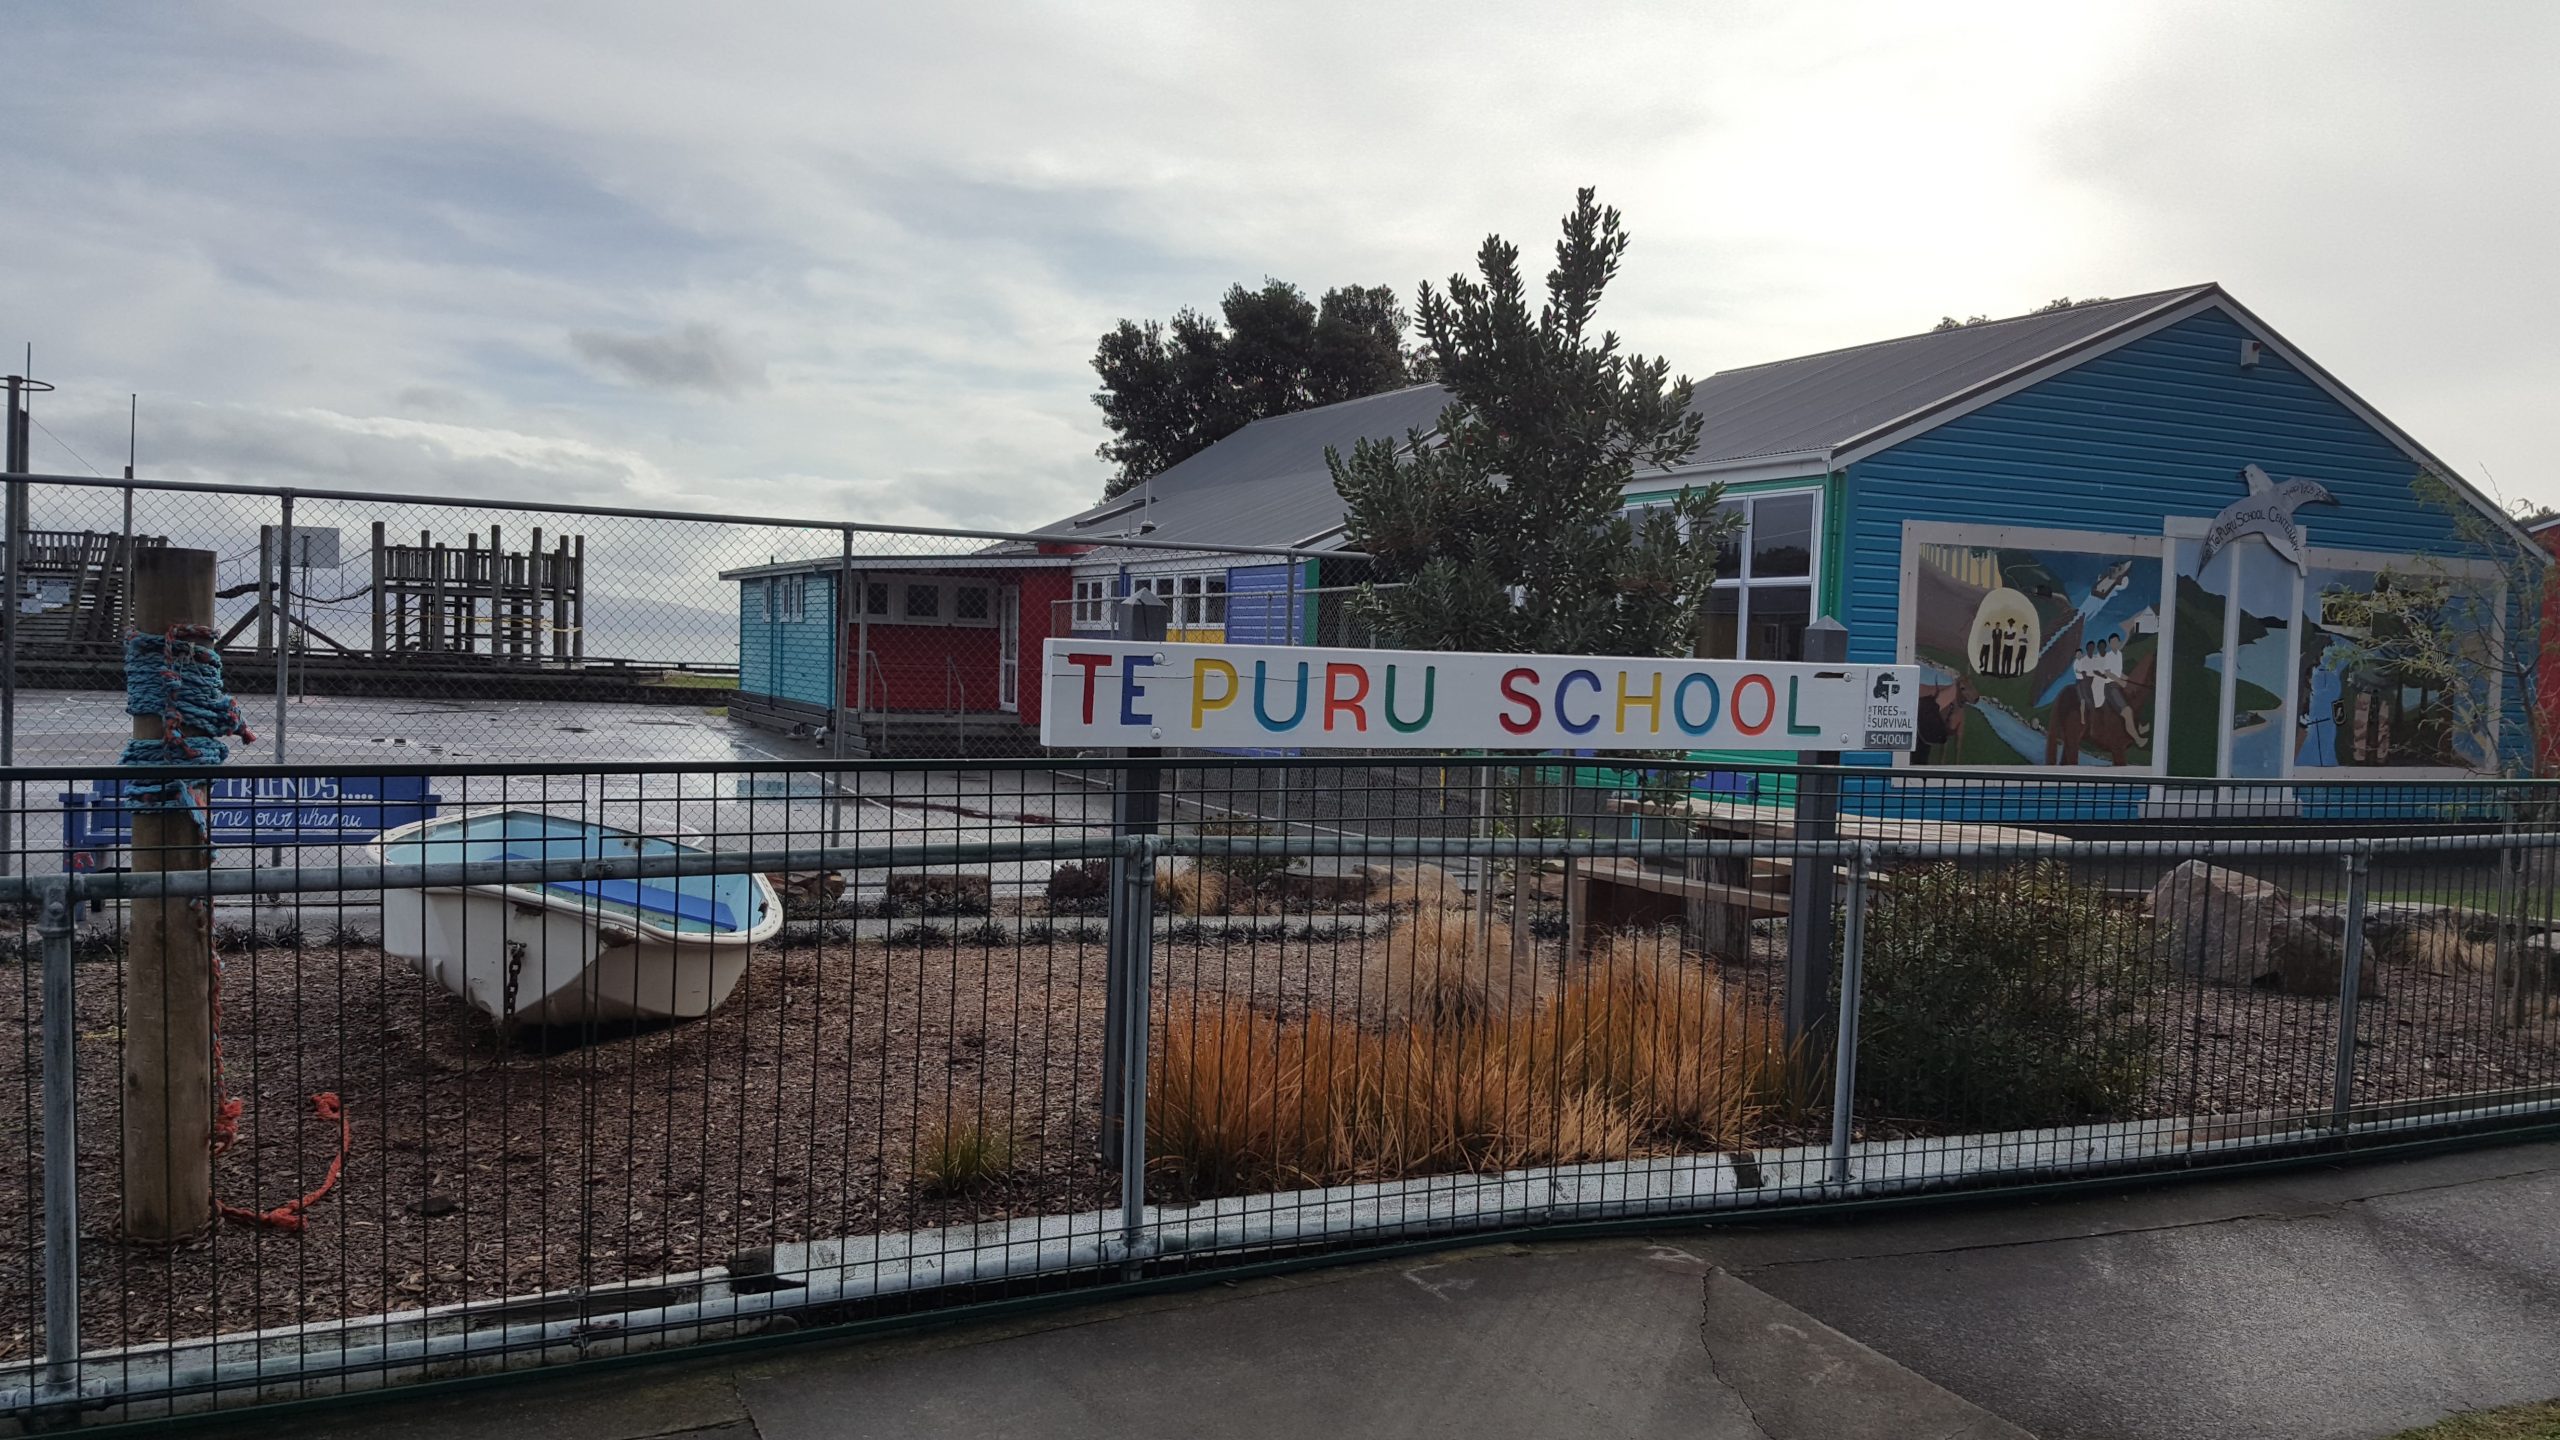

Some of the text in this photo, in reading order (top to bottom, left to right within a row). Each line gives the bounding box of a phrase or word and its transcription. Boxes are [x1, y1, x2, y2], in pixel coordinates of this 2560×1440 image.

[1067, 652, 1822, 738] TE PURU SCHOOL
[1872, 705, 1899, 716] TREES
[1871, 718, 1912, 729] SURVIVAL
[255, 810, 293, 828] our
